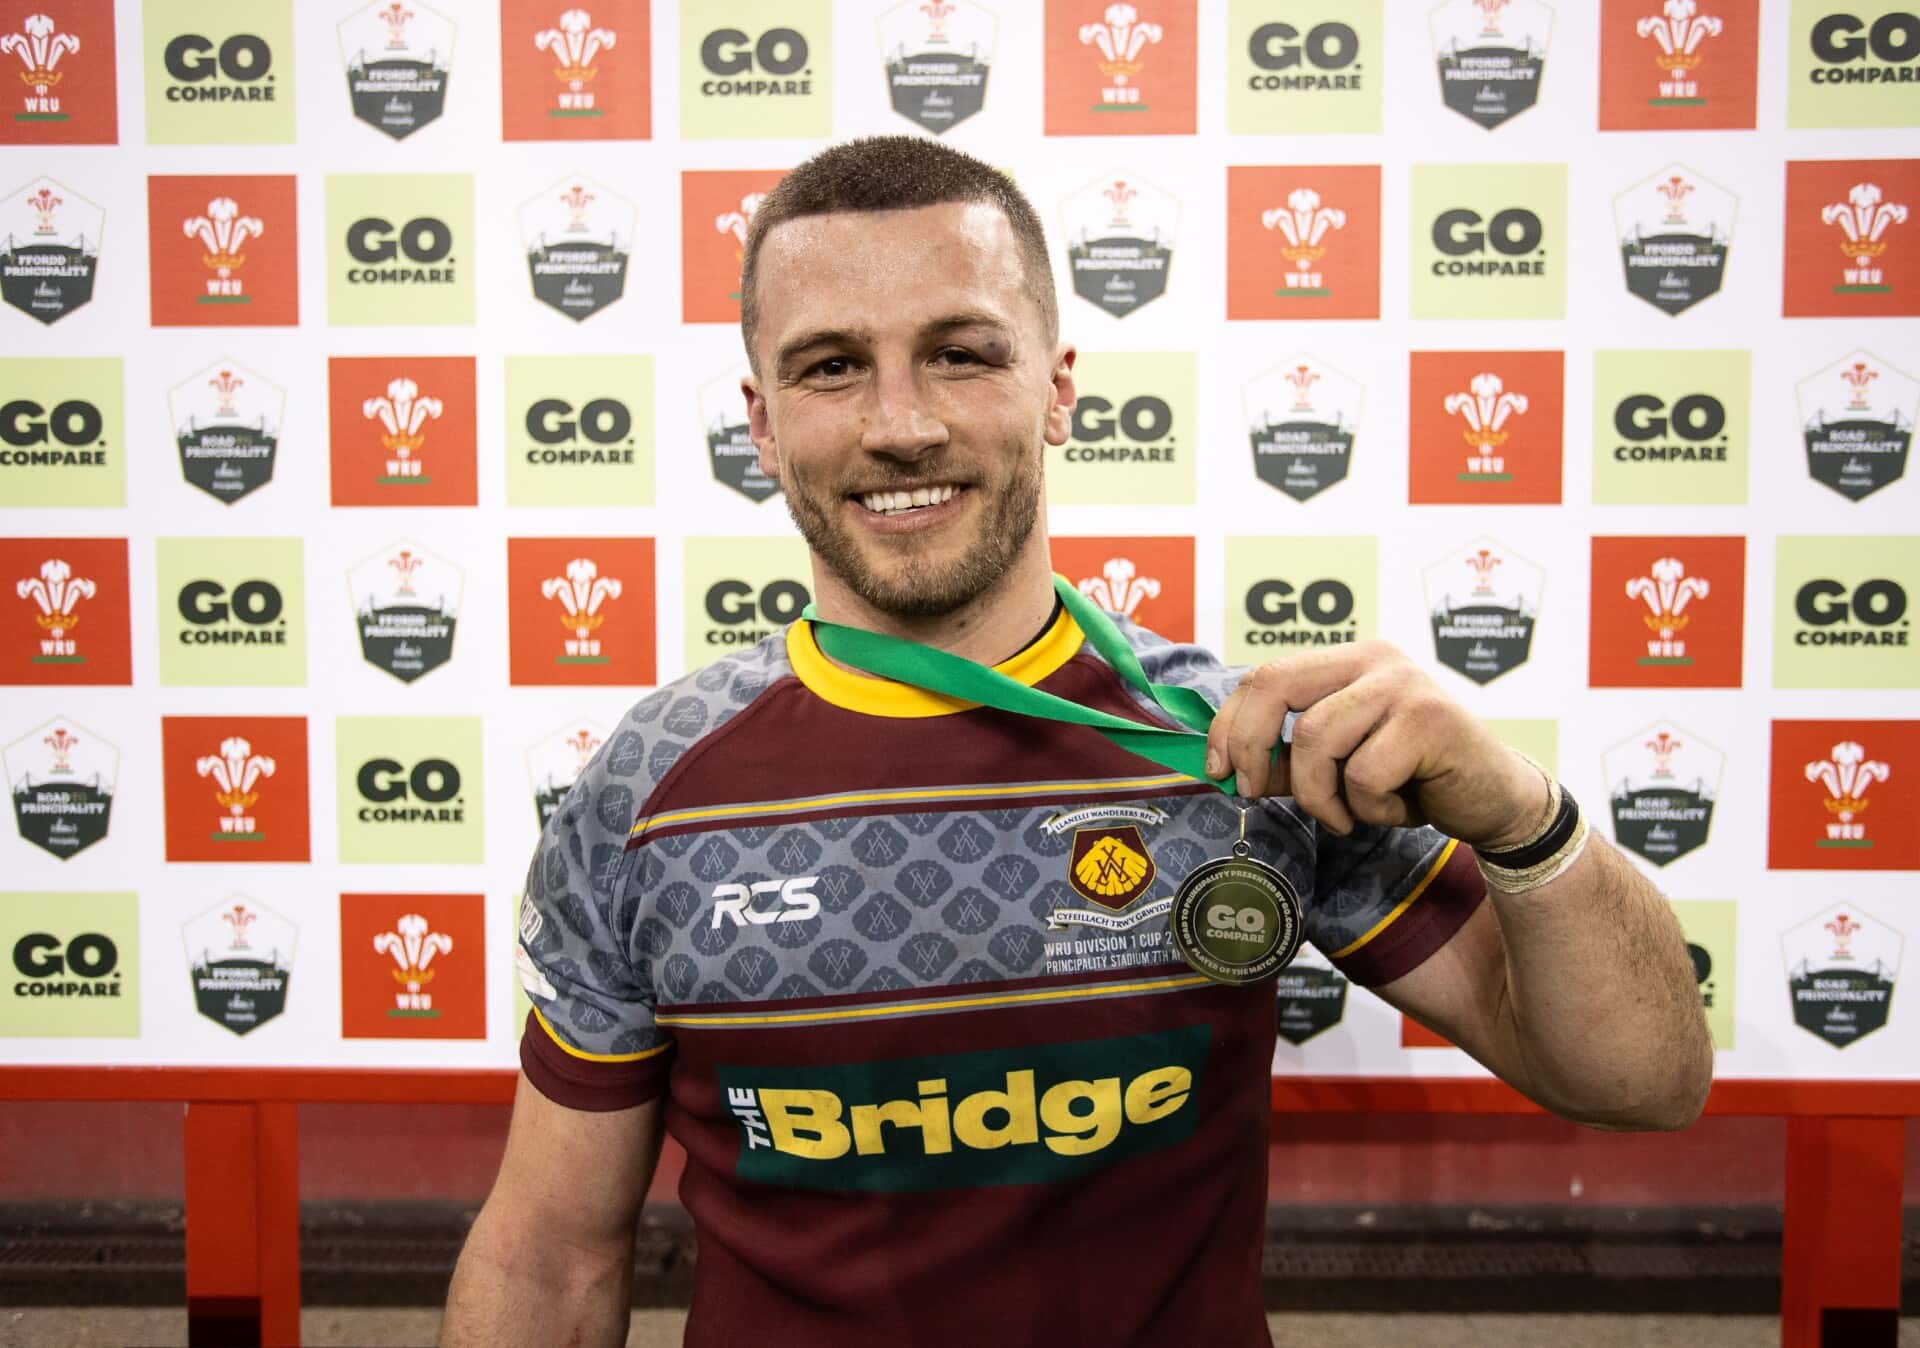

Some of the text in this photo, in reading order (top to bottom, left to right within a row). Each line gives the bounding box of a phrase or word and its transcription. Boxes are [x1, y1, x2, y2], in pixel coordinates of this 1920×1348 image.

[1248, 21, 1362, 71] GO.
[1811, 13, 1920, 64] GO
[163, 33, 275, 83] GO.
[700, 27, 812, 77] GO.
[893, 74, 981, 87] PRINCIPALITY
[1445, 68, 1535, 81] PRINCIPALITY
[354, 79, 441, 93] PRINCIPALITY
[701, 80, 811, 96] COMPARE
[1248, 74, 1361, 91] COMPARE
[1660, 81, 1696, 96] WRU
[165, 86, 274, 102] COMPARE
[559, 93, 593, 108] WRU
[1103, 88, 1139, 102] WRU
[25, 98, 59, 112] WRU
[1431, 207, 1545, 257] GO.
[345, 216, 455, 265] GO.
[1075, 258, 1164, 271] PRINCIPALITY
[1629, 254, 1719, 267] PRINCIPALITY
[4, 265, 89, 277] PRINCIPALITY
[347, 268, 454, 284] COMPARE
[535, 262, 621, 275] PRINCIPALITY
[1432, 261, 1545, 276] COMPARE
[1845, 269, 1881, 283] WRU
[208, 279, 241, 294] WRU
[1286, 272, 1321, 287] WRU
[0, 399, 106, 447] GO.
[525, 397, 635, 445] GO.
[1614, 393, 1728, 443] GO.
[185, 446, 270, 459] PRINCIPALITY
[1064, 447, 1174, 463] COMPARE
[1258, 442, 1347, 455] PRINCIPALITY
[1614, 446, 1727, 462] COMPARE
[1812, 441, 1903, 454] PRINCIPALITY
[0, 450, 106, 466] COMPARE
[526, 449, 633, 464] COMPARE
[387, 460, 421, 475] WRU
[1468, 457, 1504, 472] WRU
[177, 579, 286, 626] GO.
[705, 580, 811, 625] GO
[1245, 579, 1357, 627] GO.
[1795, 578, 1910, 627] GO.
[179, 630, 285, 645] COMPARE
[365, 625, 448, 638] PRINCIPALITY
[706, 630, 770, 646] COMP
[1245, 630, 1356, 647] COMPARE
[1439, 625, 1527, 639] PRINCIPALITY
[1795, 631, 1908, 646] COMPARE
[41, 640, 75, 654] WRU
[566, 640, 600, 655] WRU
[1648, 641, 1684, 656] WRU
[356, 758, 464, 804] GO.
[21, 802, 105, 815] PRINCIPALITY
[358, 808, 463, 822] COMPARE
[1090, 809, 1138, 817] WANDERERS
[1618, 808, 1707, 822] PRINCIPALITY
[221, 816, 254, 832] WRU
[1828, 824, 1864, 839] WRU
[1185, 870, 1230, 909] PRINCIPALITY
[1231, 870, 1278, 893] PRESENTED
[1275, 891, 1287, 903] BY
[711, 875, 822, 930] RCS
[1111, 917, 1135, 929] TRWY
[1206, 928, 1265, 944] COMPARE
[1044, 941, 1071, 957] WRU
[1075, 936, 1127, 955] DIVISION
[1131, 935, 1137, 949] 1
[1139, 932, 1162, 948] CUP
[12, 932, 121, 979] GO.
[1046, 955, 1108, 974] PRINCIPALITY
[1111, 951, 1150, 968] STADIUM
[1191, 947, 1219, 971] PLAYER
[1219, 966, 1231, 975] OF
[1231, 966, 1249, 976] THE
[1248, 954, 1278, 975] MATCH
[13, 981, 120, 997] COMPARE
[199, 979, 282, 992] PRINCIPALITY
[397, 994, 430, 1009] WRU
[1797, 989, 1888, 1001] PRINCIPALITY
[727, 1065, 1193, 1161] THE Bridge
